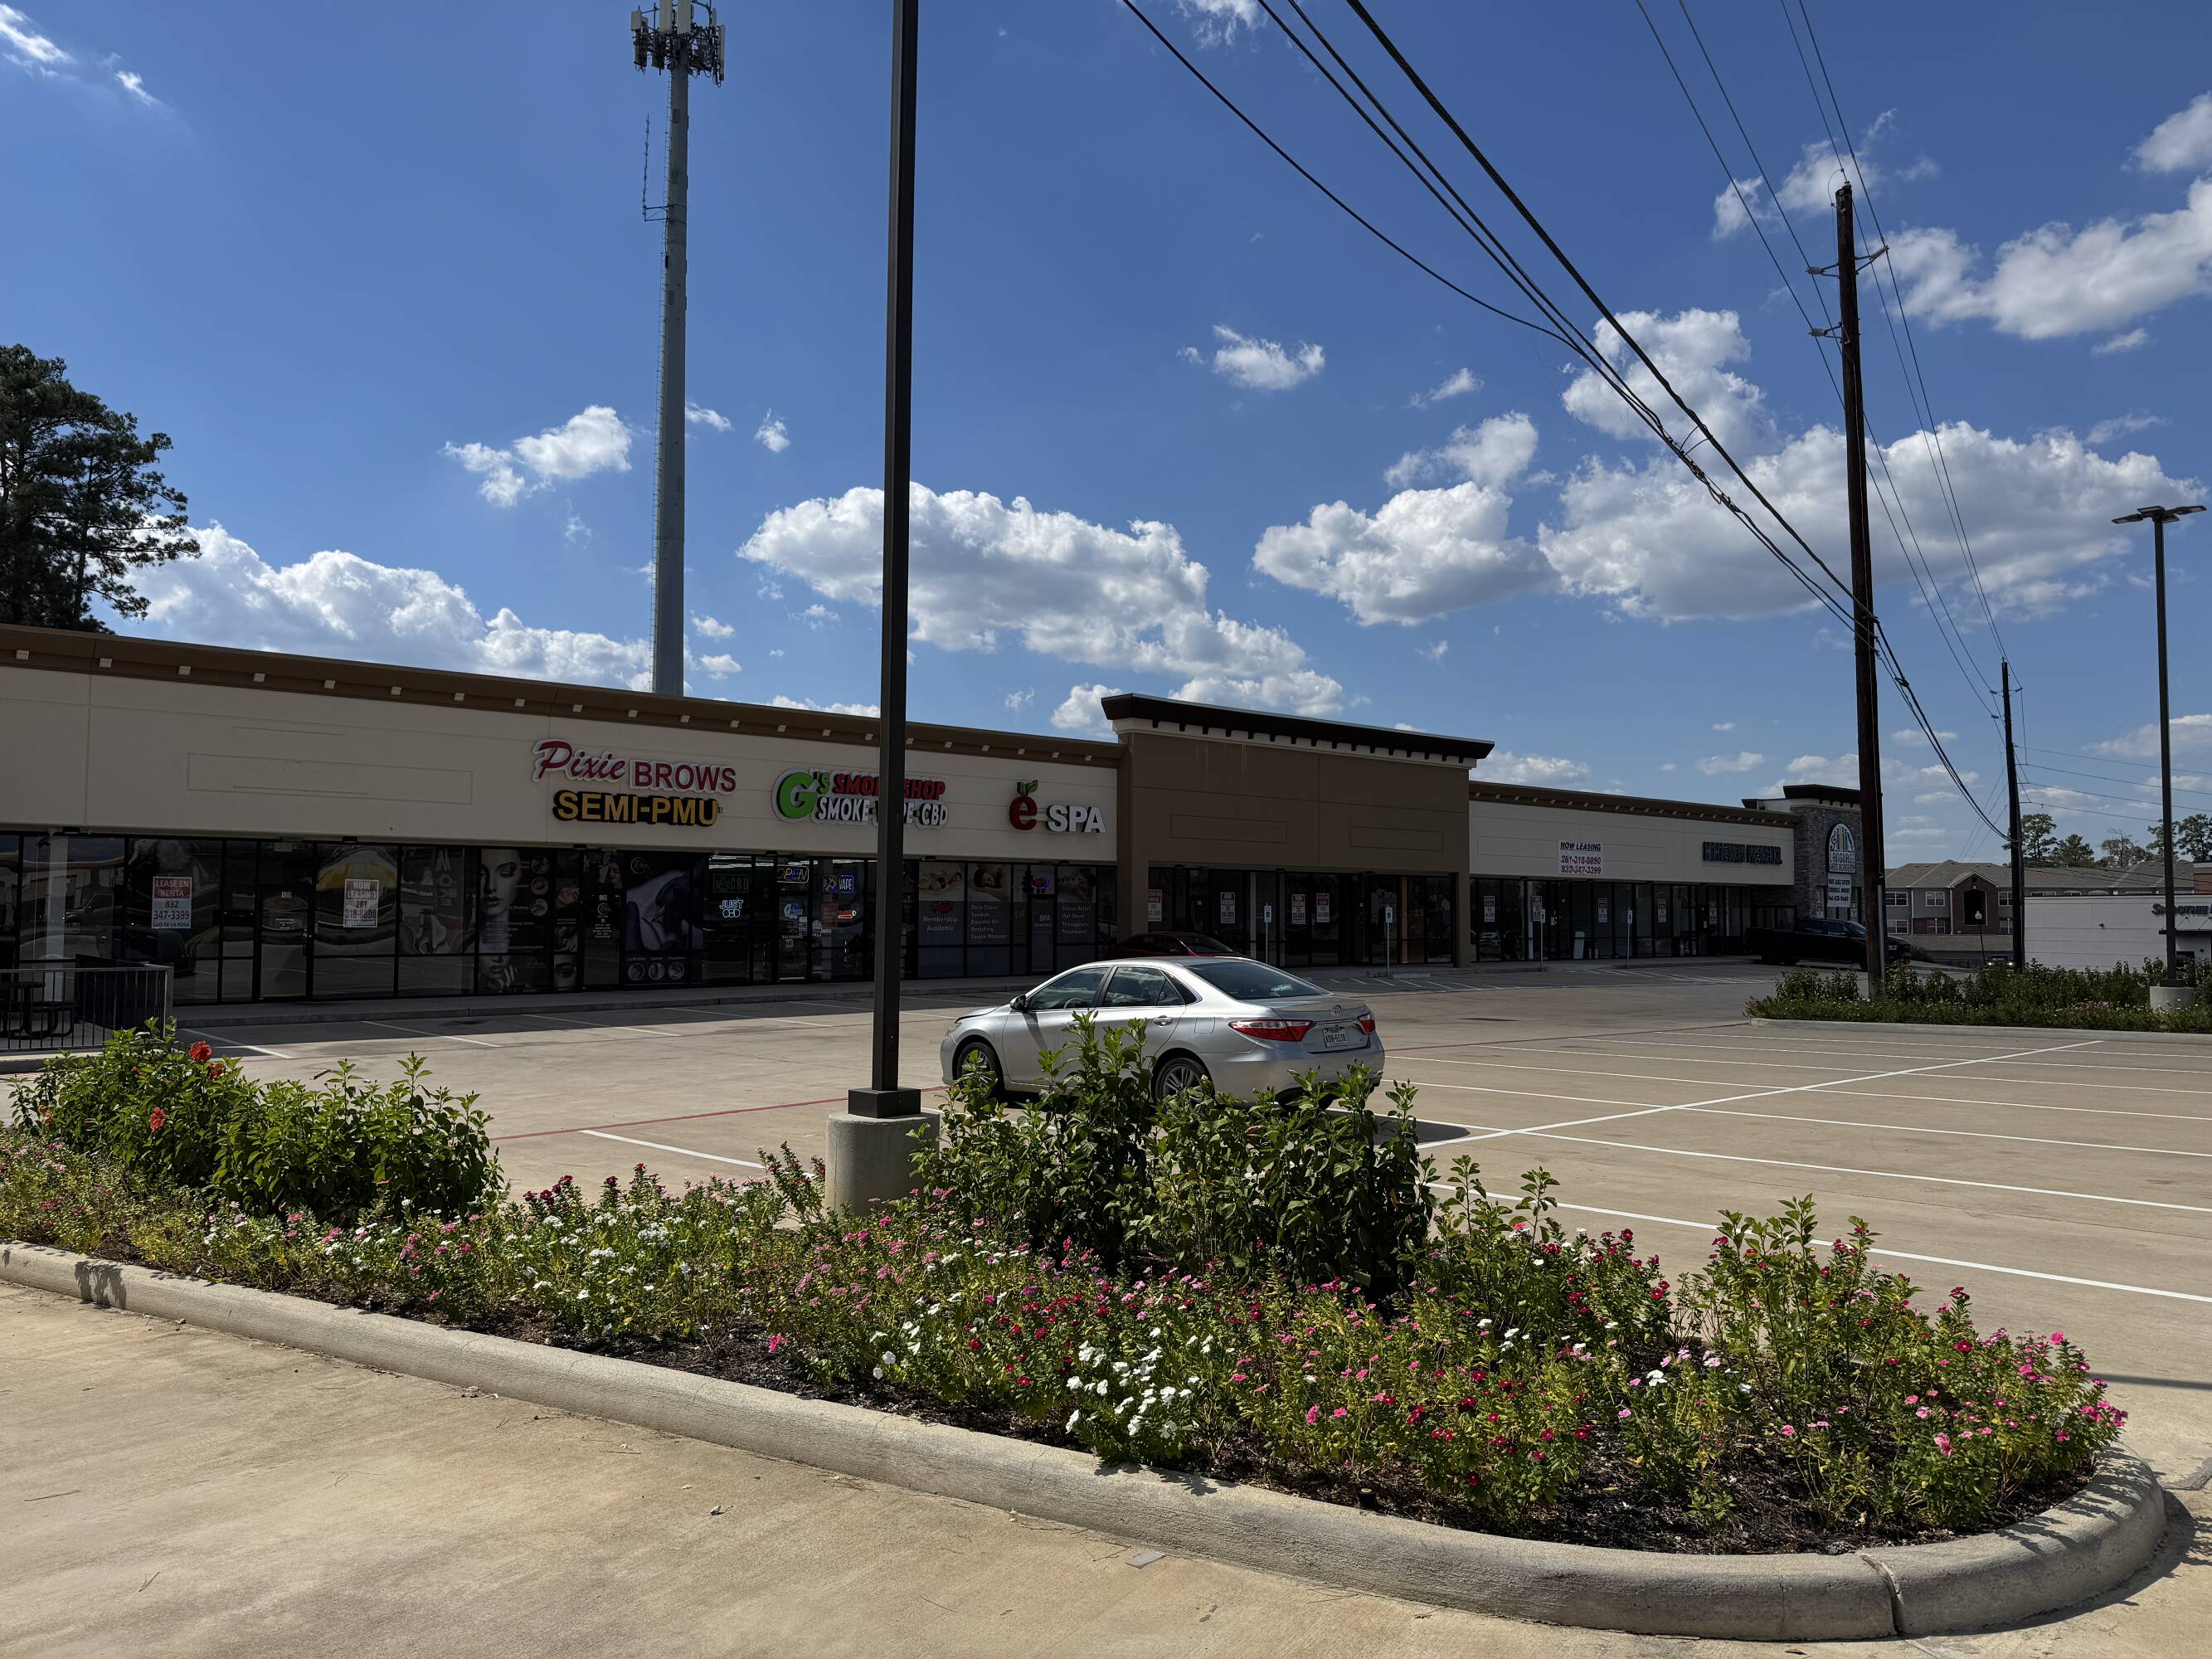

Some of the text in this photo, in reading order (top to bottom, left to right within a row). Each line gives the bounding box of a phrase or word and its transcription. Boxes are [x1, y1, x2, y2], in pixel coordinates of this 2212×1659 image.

[538, 741, 737, 792] Pixie BROWS
[834, 773, 879, 796] SMO
[555, 791, 717, 825] SEMI-PMU
[817, 797, 871, 821] SMOKE
[921, 803, 949, 826] CBD
[1048, 805, 1106, 833] SPA
[1576, 843, 1601, 851] LEASING
[354, 881, 371, 890] NOW
[839, 878, 853, 891] VAPE
[347, 890, 376, 899] LEASING
[165, 900, 179, 908] 832
[356, 900, 367, 909] 281
[719, 899, 744, 909] JUST
[2151, 902, 2210, 916] SMOTHIE
[153, 910, 190, 920] 347-3399
[922, 915, 959, 923] Membership
